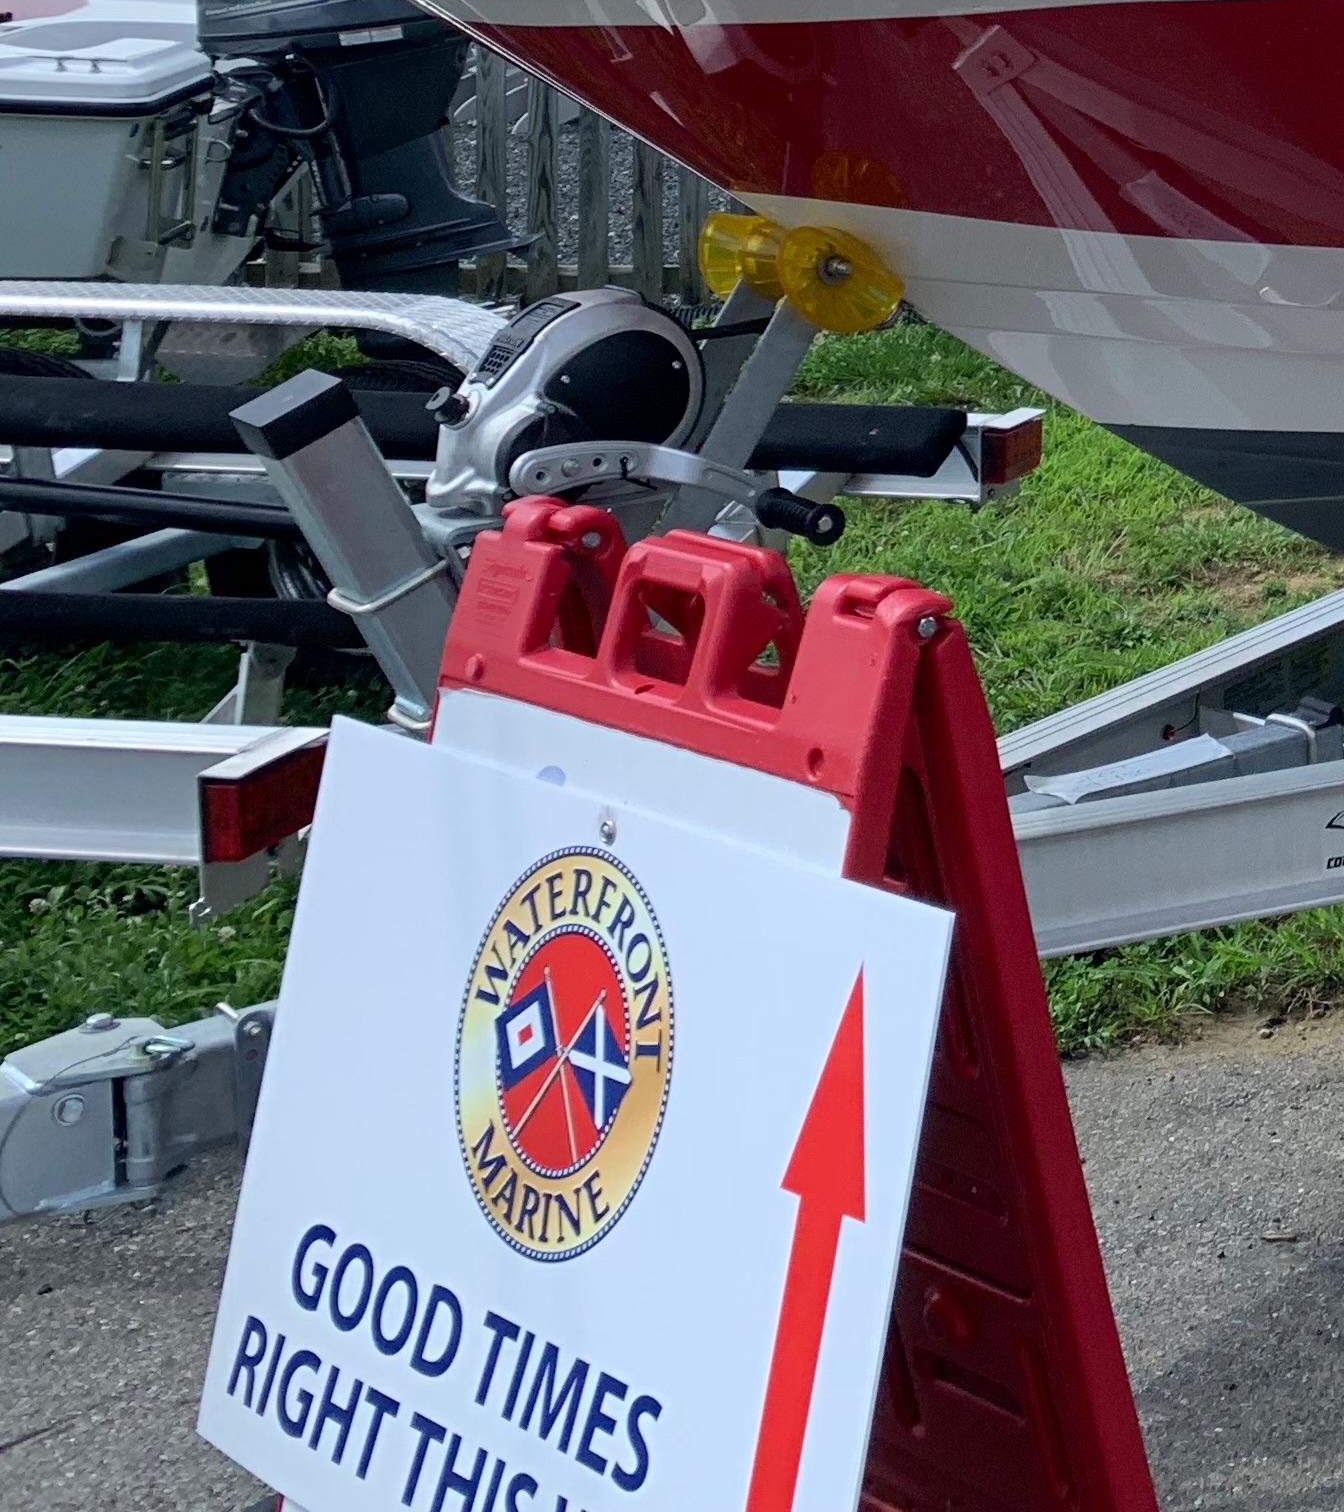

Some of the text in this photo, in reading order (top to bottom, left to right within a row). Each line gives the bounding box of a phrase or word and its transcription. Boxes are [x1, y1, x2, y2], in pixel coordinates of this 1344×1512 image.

[474, 867, 663, 1073] WATERFRONT
[471, 1119, 610, 1244] MARINE
[226, 1314, 401, 1481] RIGHT
[291, 1224, 663, 1493] GOOD TIMES
